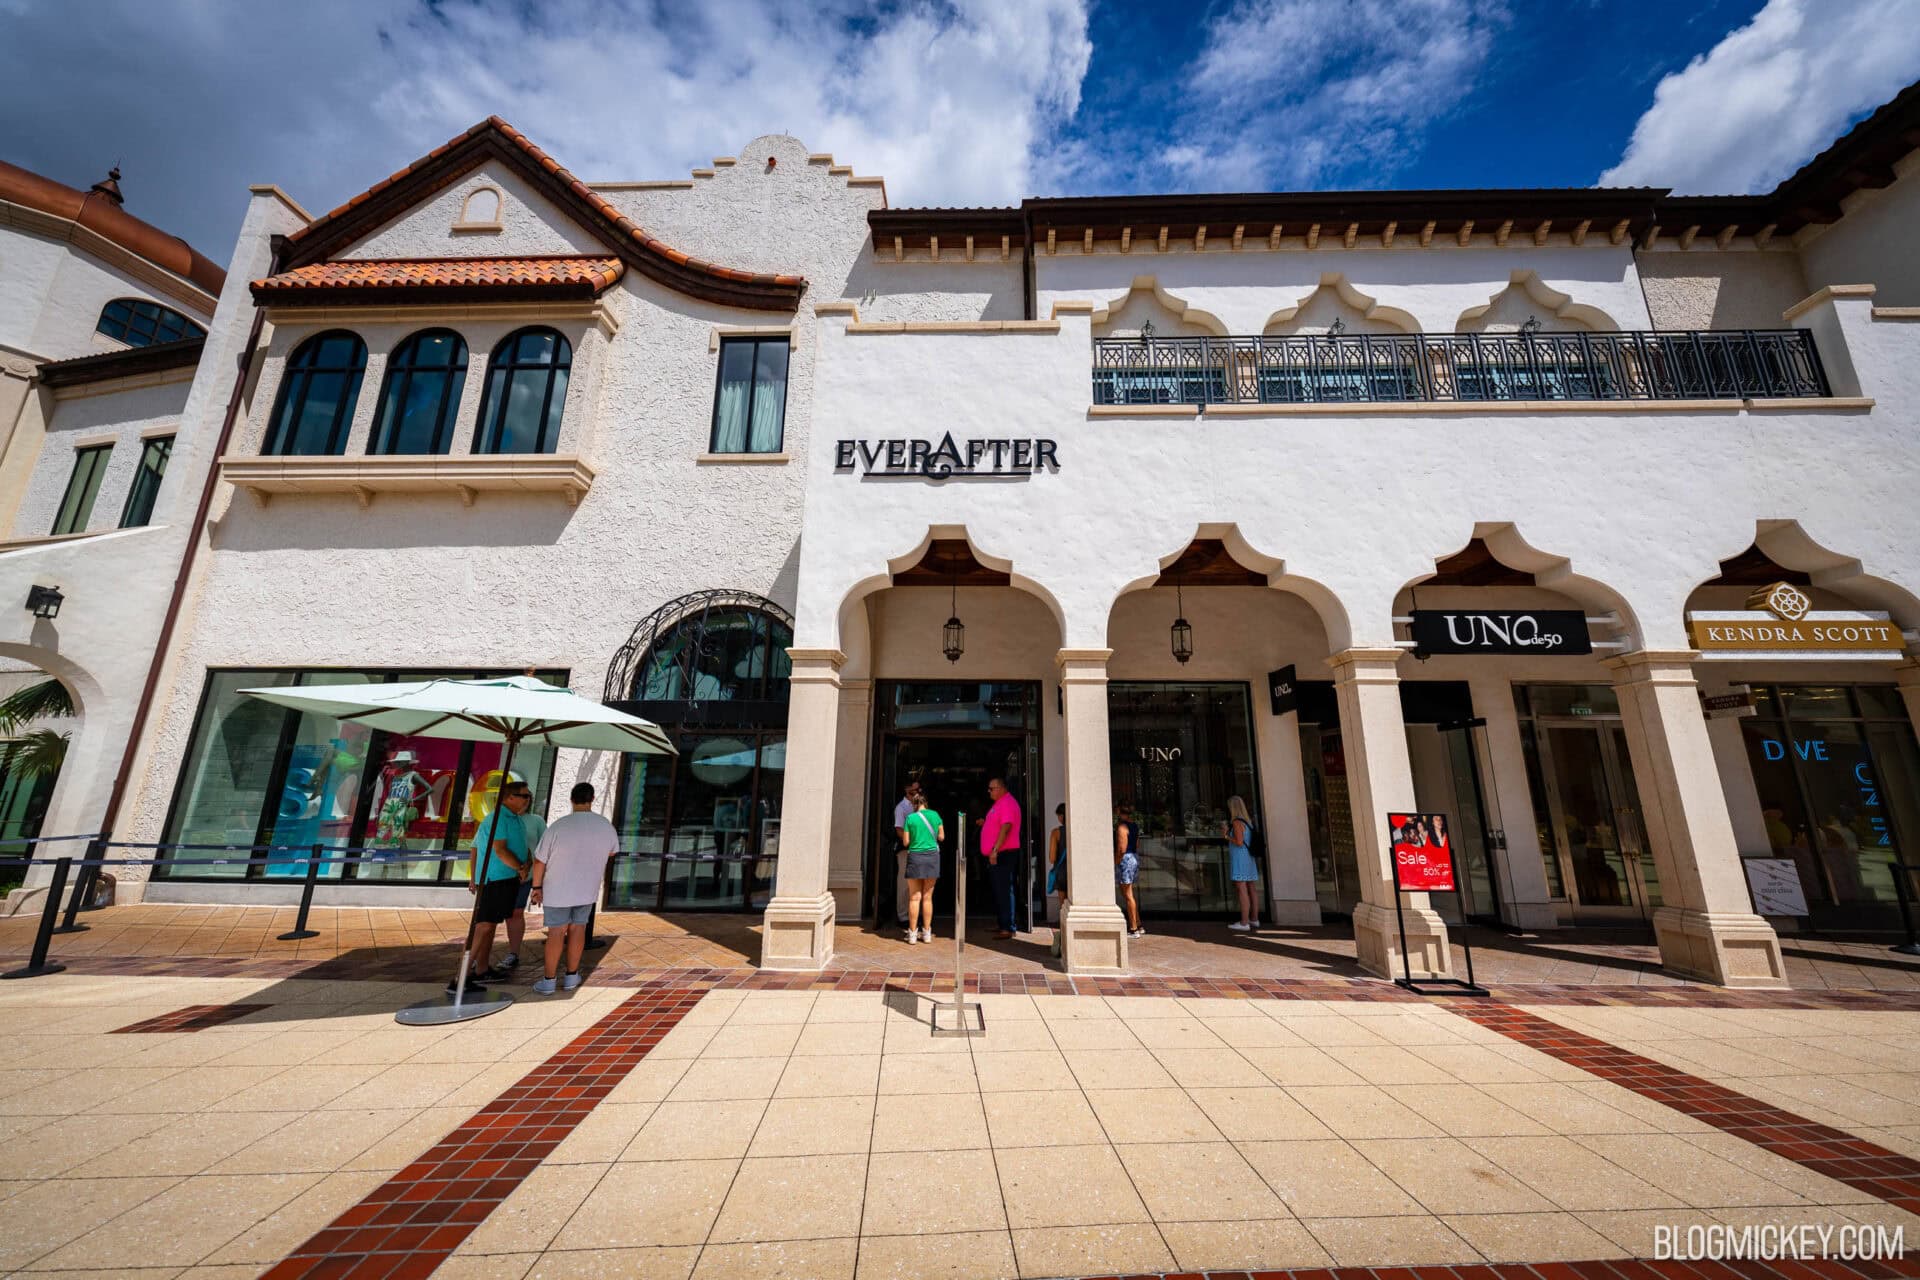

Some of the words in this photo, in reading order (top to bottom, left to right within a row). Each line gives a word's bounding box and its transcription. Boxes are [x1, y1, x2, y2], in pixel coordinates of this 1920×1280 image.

[1707, 627, 1805, 642] KENDRA
[1813, 627, 1889, 642] SCOTT
[1397, 851, 1427, 865] Sale
